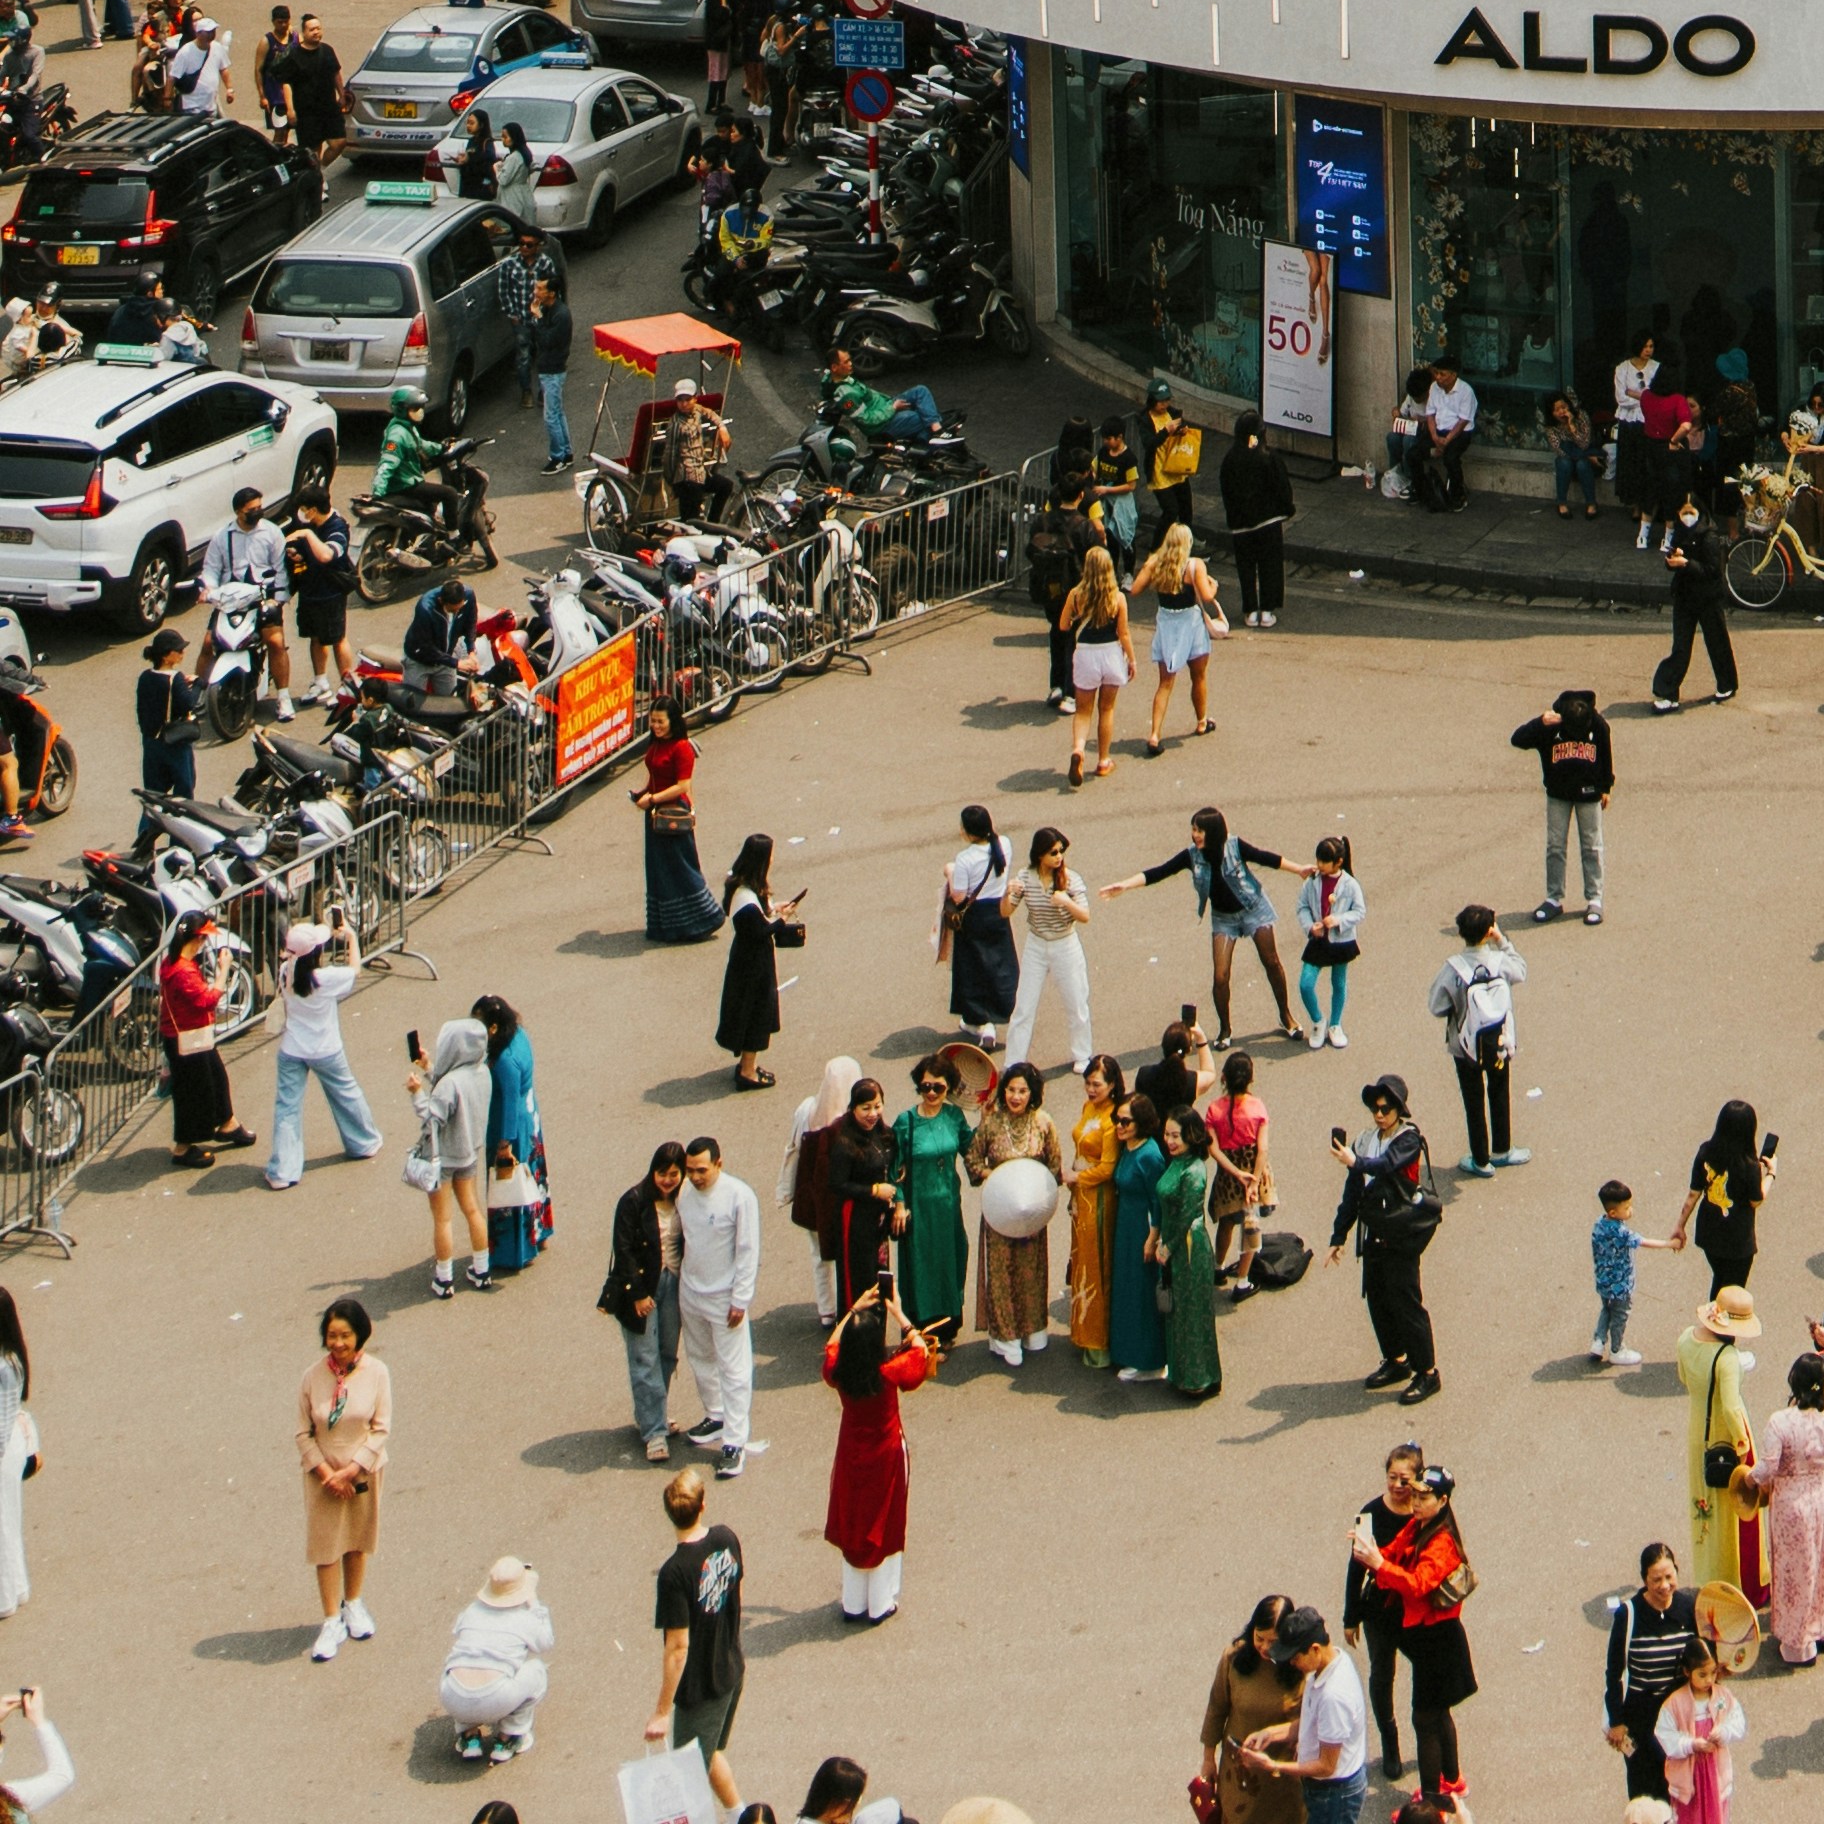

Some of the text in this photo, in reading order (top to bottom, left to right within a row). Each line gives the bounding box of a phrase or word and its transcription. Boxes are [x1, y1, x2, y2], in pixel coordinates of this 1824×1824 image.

[1434, 6, 1757, 77] ALDO
[405, 184, 431, 197] TAXI
[1281, 409, 1314, 424] ALDO
[575, 673, 598, 702] KHU
[621, 677, 634, 704] XE
[1552, 741, 1597, 764] CHICAGO
